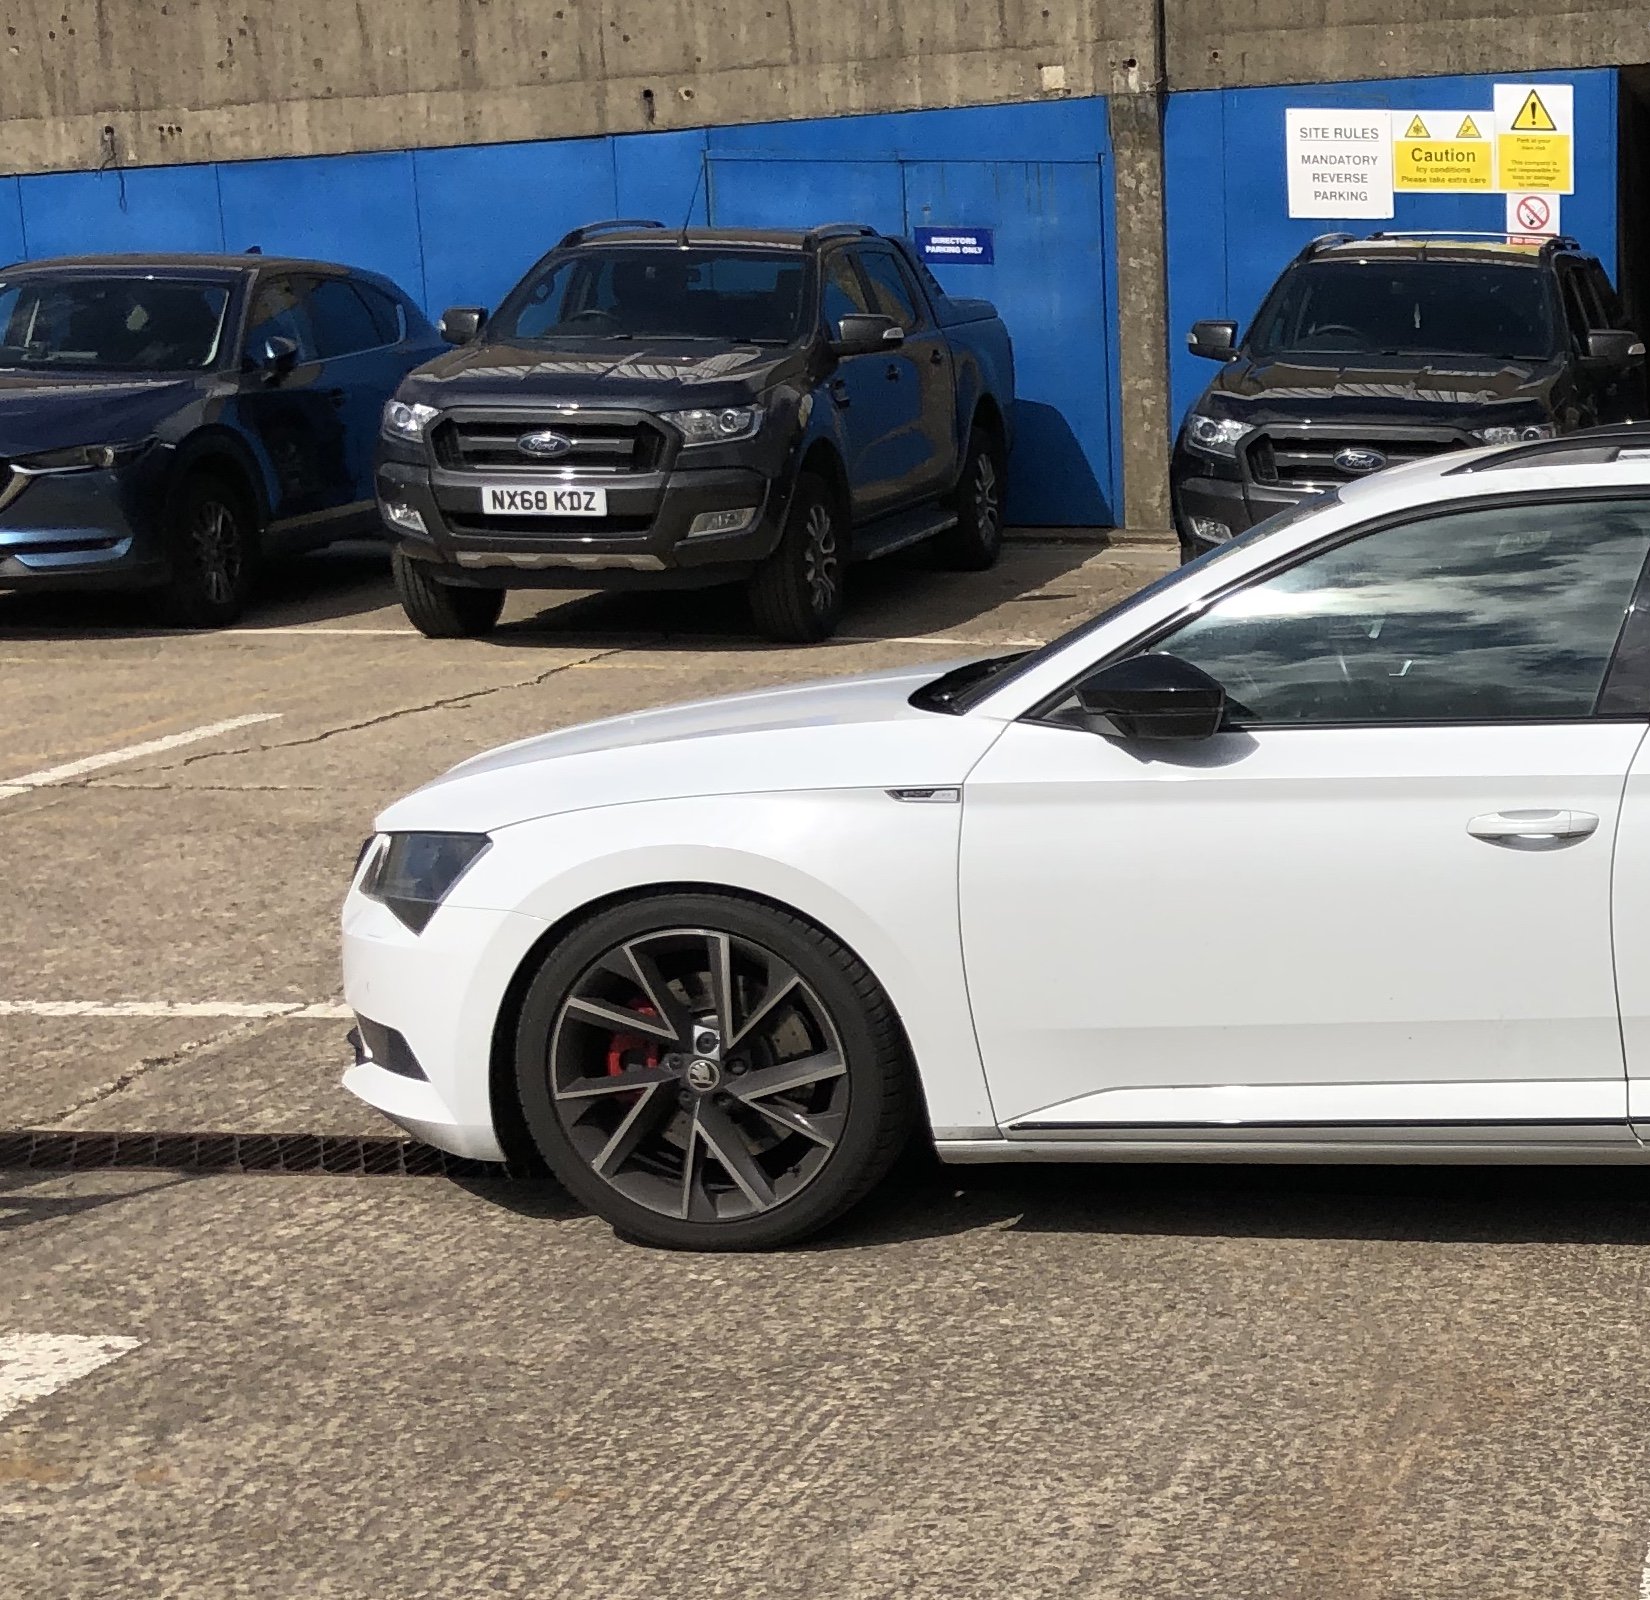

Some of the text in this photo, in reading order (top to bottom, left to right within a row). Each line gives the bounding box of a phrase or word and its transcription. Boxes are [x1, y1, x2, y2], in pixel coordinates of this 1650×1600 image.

[1299, 127, 1379, 140] SITE RULES
[1301, 154, 1378, 166] MANDATORY
[1411, 147, 1476, 162] Caution
[1416, 166, 1471, 174] Icy conditions
[1312, 172, 1368, 184] REVERSE
[1401, 175, 1427, 183] Please
[1313, 190, 1368, 202] PARKING
[930, 236, 977, 245] DIRECTORS
[925, 245, 984, 254] PARKING ONLY
[528, 437, 557, 451] Ford
[1345, 453, 1376, 467] Ford
[491, 489, 597, 512] NX68 KDZ
